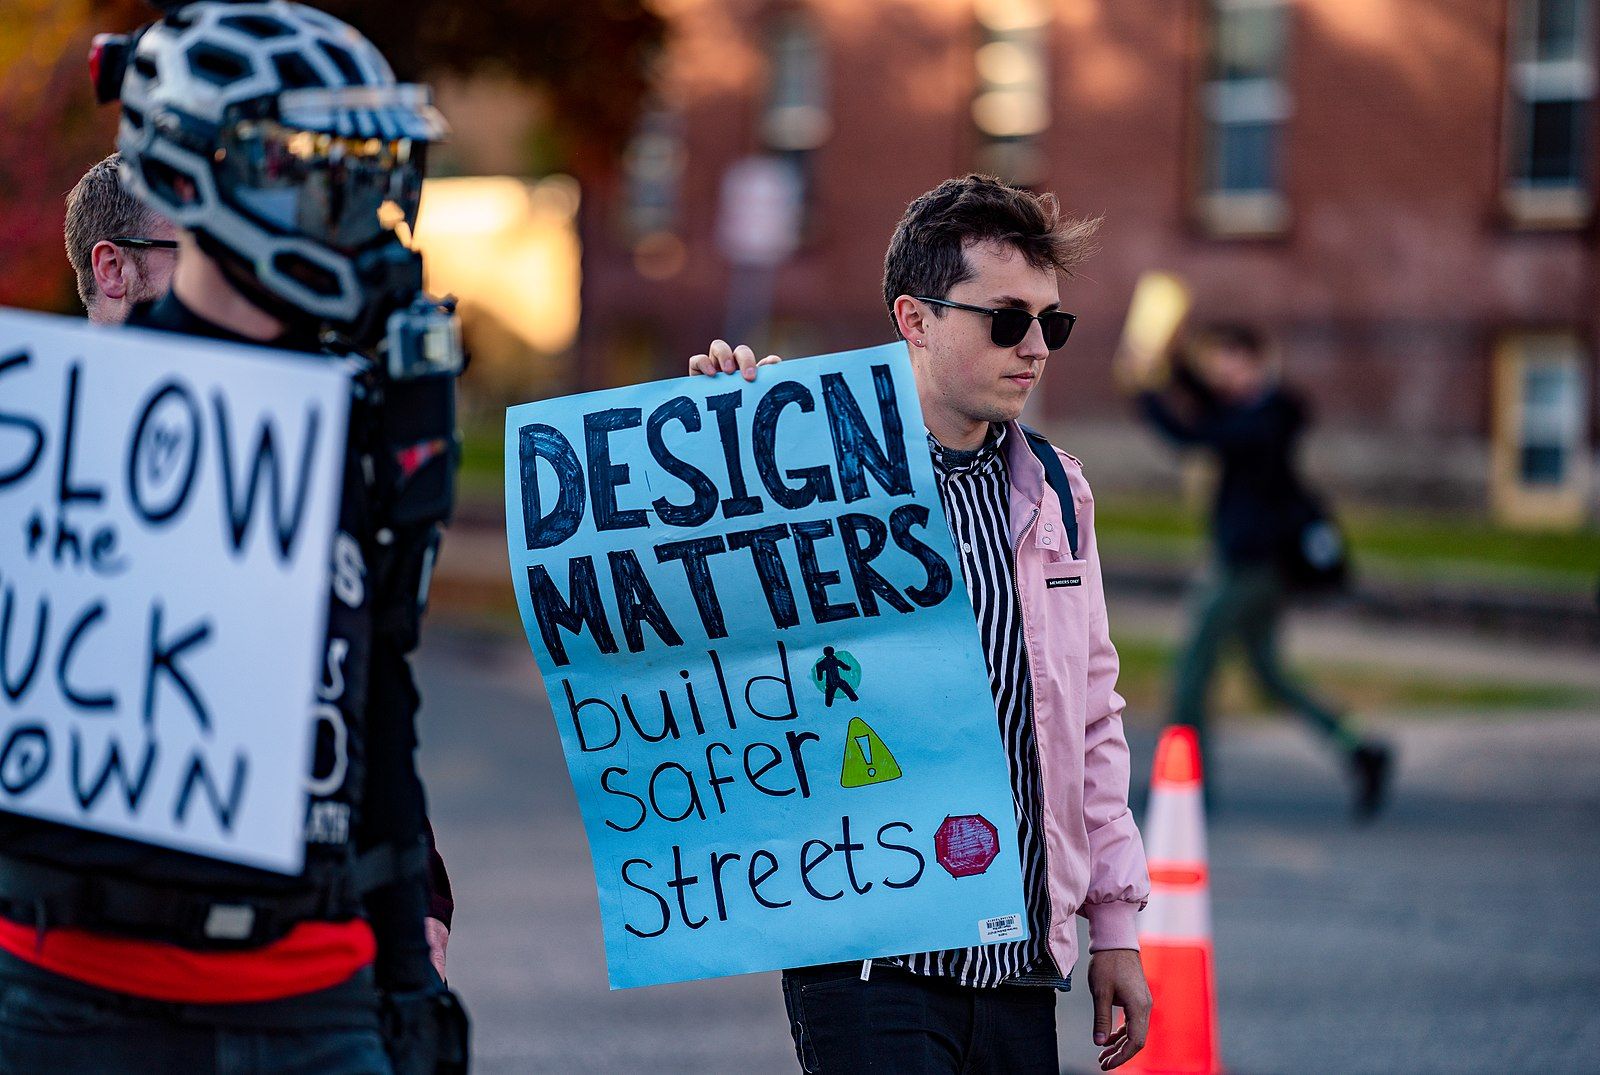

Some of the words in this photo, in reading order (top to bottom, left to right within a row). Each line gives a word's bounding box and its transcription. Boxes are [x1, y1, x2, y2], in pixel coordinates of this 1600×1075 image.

[0, 347, 321, 567] SLOW
[518, 363, 916, 551] DESIGN
[24, 504, 130, 577] the
[526, 503, 954, 667] MATTERS
[0, 579, 213, 734] UCK
[561, 640, 800, 753] build
[0, 720, 250, 834] OWN
[600, 730, 821, 833] safer
[620, 815, 926, 939] streets
